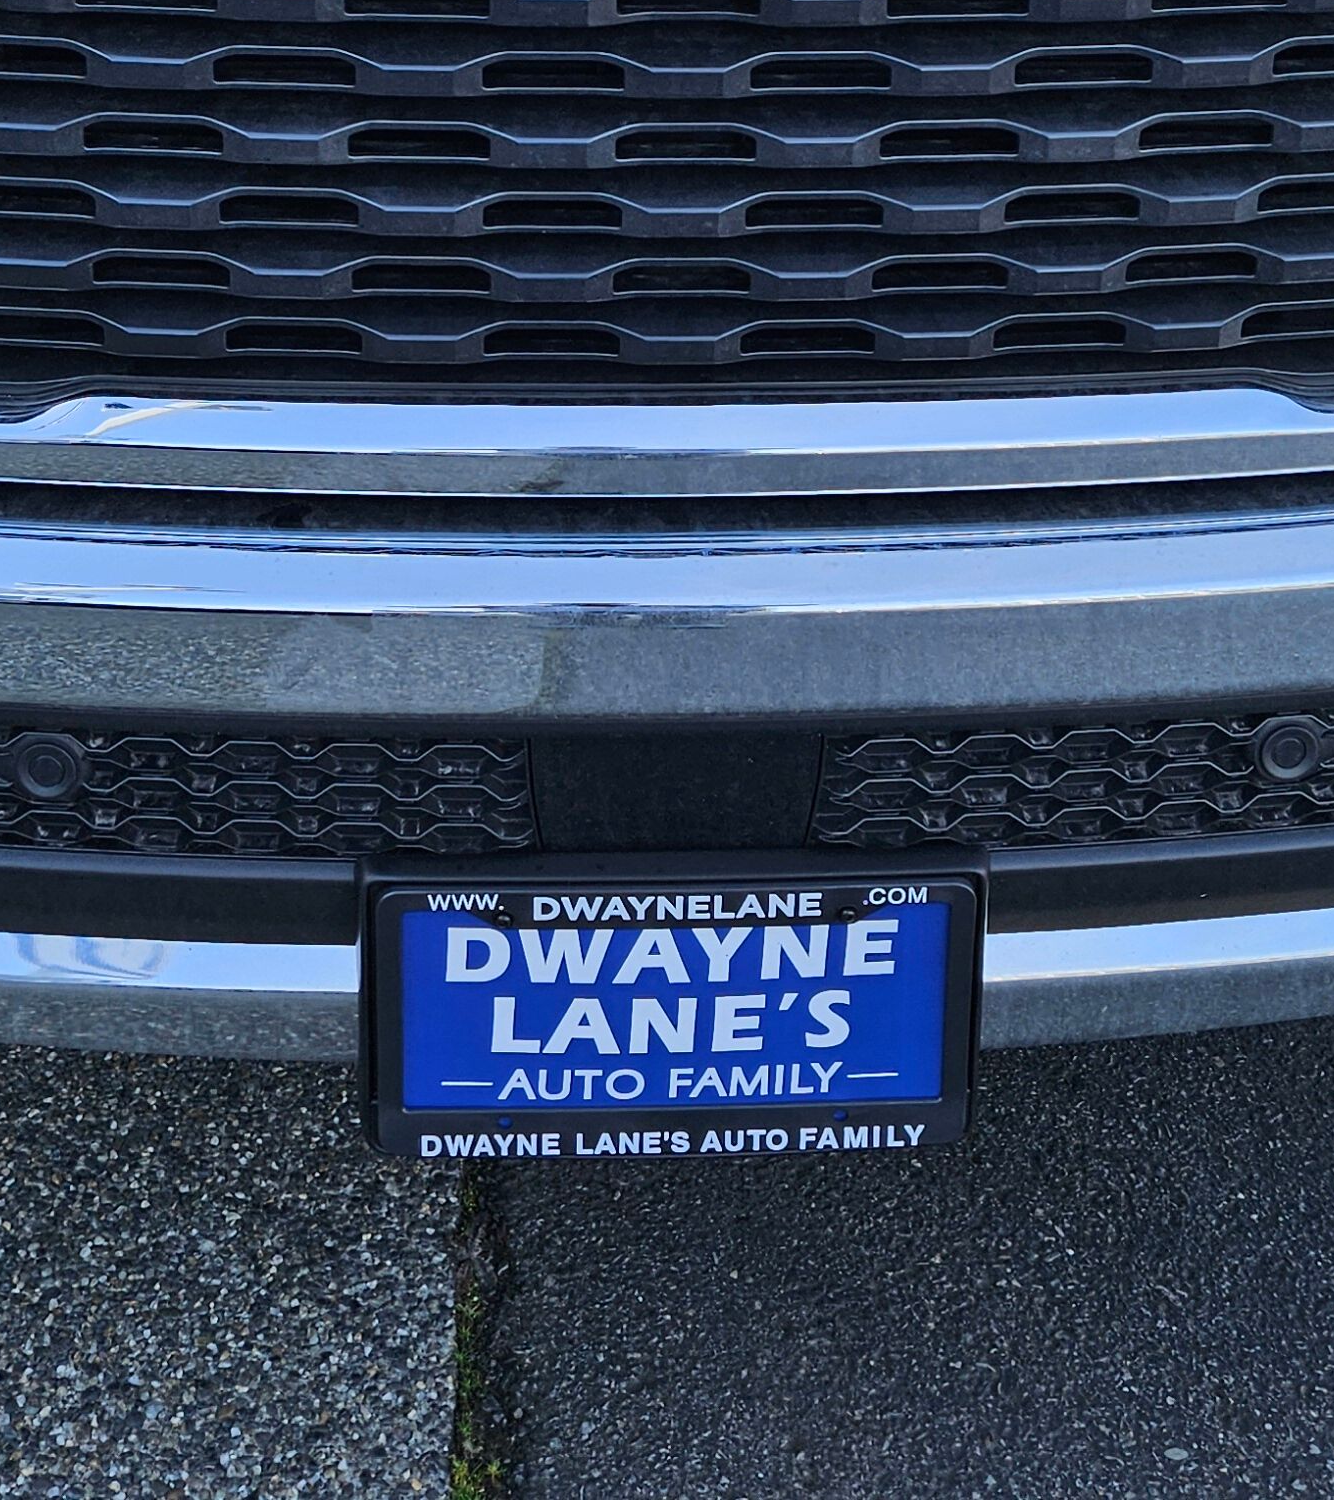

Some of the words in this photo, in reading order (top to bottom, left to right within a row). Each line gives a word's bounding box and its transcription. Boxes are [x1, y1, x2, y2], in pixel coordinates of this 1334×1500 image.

[532, 892, 823, 922] DWAYNELANE
[863, 886, 928, 905] .COM
[445, 919, 899, 984] DWAYNE
[490, 989, 851, 1055] LANE'S
[497, 1068, 646, 1100] AUTO
[668, 1061, 844, 1098] FAMILY
[420, 1133, 561, 1157] DWAYNE
[576, 1130, 691, 1155] LANE'S
[699, 1128, 789, 1153] AUTO
[798, 1124, 926, 1150] FAMILY
